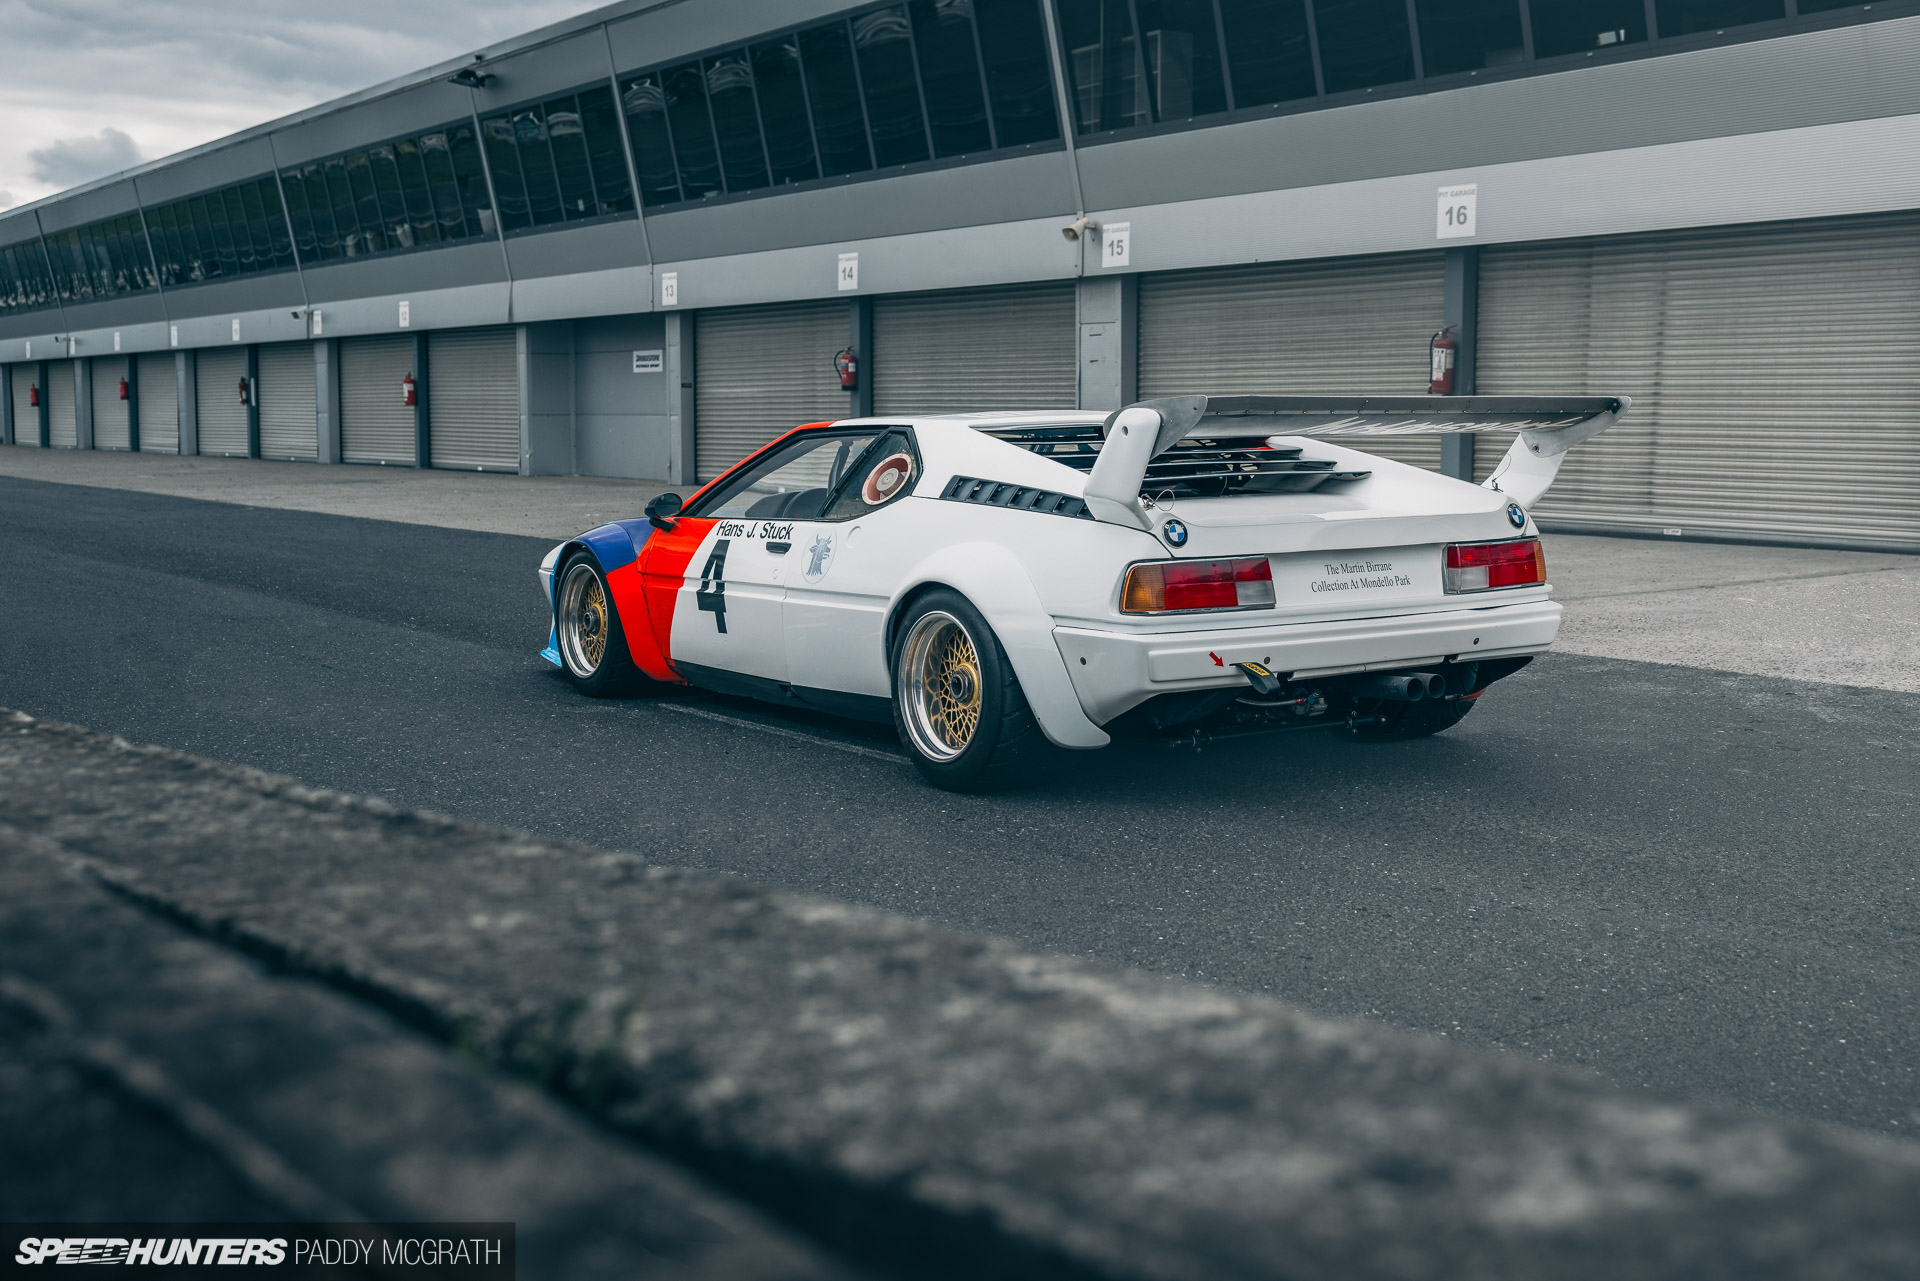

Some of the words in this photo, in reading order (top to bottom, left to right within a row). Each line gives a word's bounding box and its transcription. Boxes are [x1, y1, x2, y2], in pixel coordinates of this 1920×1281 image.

[1450, 189, 1475, 197] GARAGE
[1445, 205, 1467, 226] 16
[1108, 239, 1124, 256] 15
[842, 266, 853, 280] 14
[665, 284, 674, 297] 13
[716, 521, 744, 537] Hans
[746, 521, 758, 539] J.
[760, 522, 794, 540] Stuck
[1324, 563, 1340, 575] The
[1340, 562, 1366, 574] Martin
[1366, 561, 1393, 573] Birrane
[696, 539, 731, 634] 4
[1311, 580, 1350, 593] Collection
[1350, 579, 1360, 590] At
[1359, 576, 1394, 589] Mondello
[1394, 575, 1411, 586] Park
